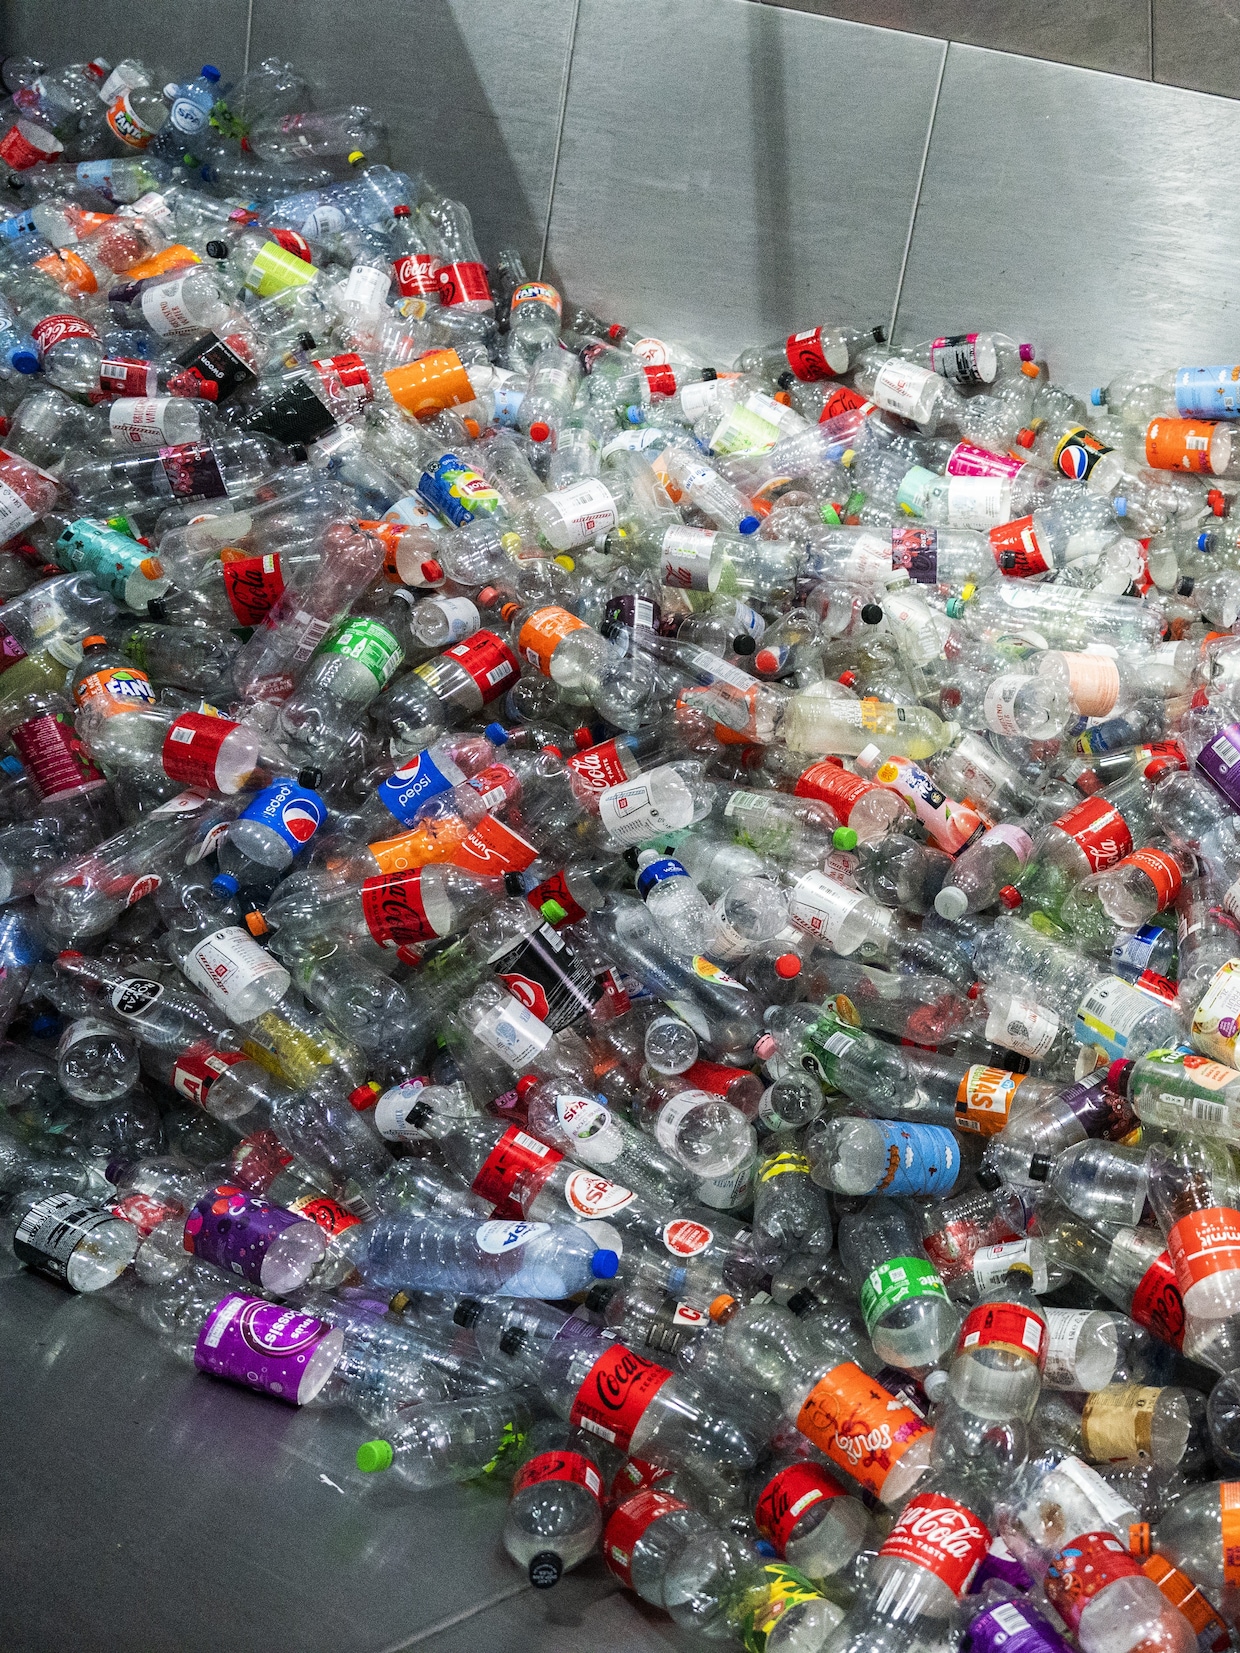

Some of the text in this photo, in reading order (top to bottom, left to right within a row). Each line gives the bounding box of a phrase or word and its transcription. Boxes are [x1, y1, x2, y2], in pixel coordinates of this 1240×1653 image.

[201, 356, 225, 379] gwoon
[266, 785, 294, 818] pepsi
[398, 774, 432, 806] pepsi
[124, 982, 155, 1012] ROYAL
[563, 1100, 589, 1123] SPA
[915, 1540, 947, 1561] TASTE
